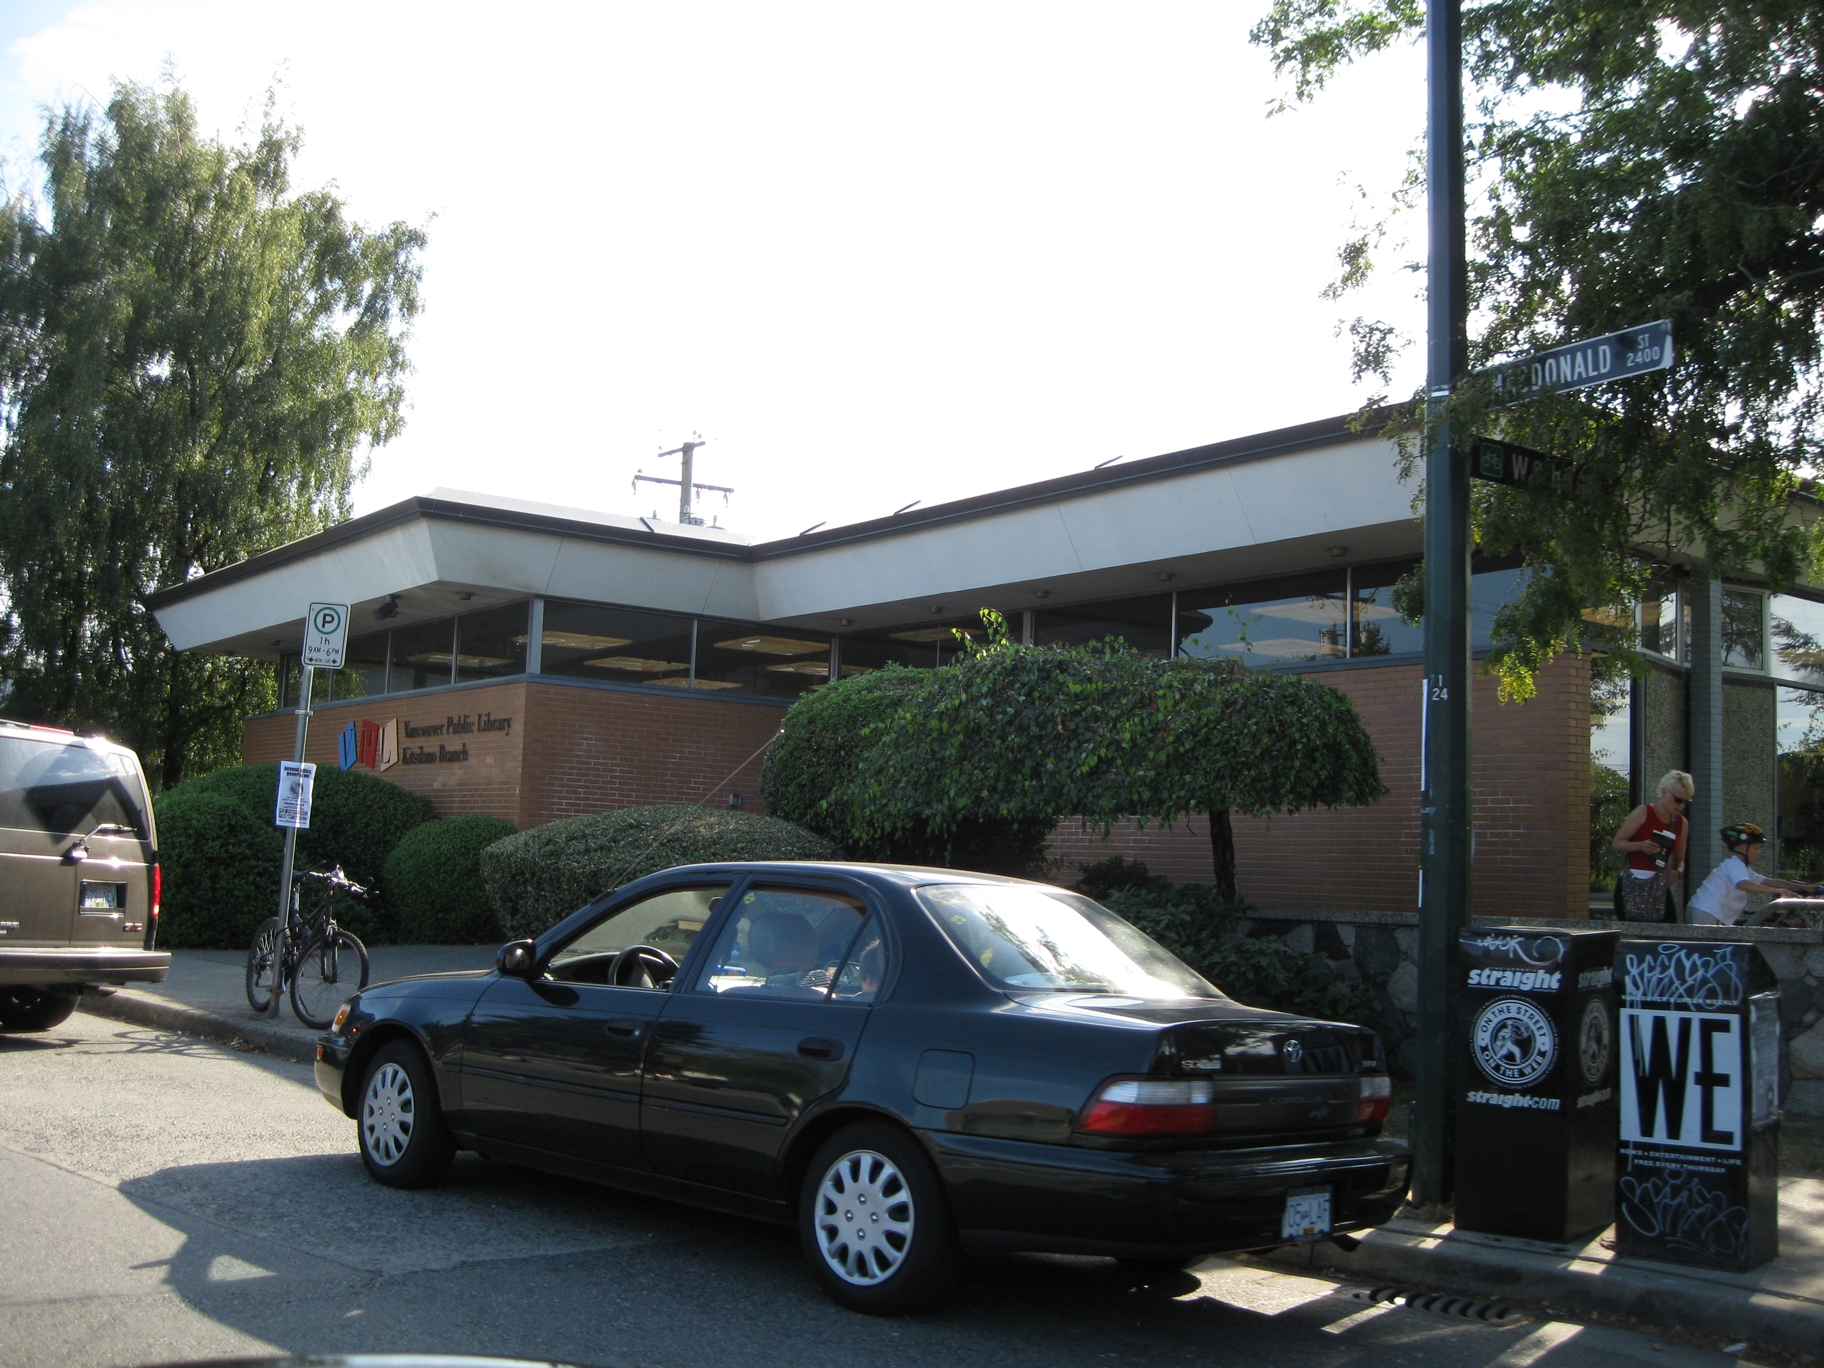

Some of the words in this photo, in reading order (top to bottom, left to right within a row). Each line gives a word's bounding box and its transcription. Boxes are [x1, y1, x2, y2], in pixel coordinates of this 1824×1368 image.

[1638, 334, 1649, 349] ST
[1627, 346, 1660, 367] 2400
[1511, 454, 1529, 481] W
[321, 613, 335, 629] P
[1432, 688, 1449, 701] 24
[404, 720, 445, 738] Vancouver
[446, 715, 475, 735] Public
[477, 712, 512, 736] Library
[439, 742, 469, 762] Branch
[1467, 967, 1562, 991] straight
[1481, 1017, 1493, 1033] ON
[1491, 1005, 1512, 1018] THE
[1516, 1006, 1547, 1037] STREET
[1483, 1051, 1497, 1068] ON
[1499, 1067, 1520, 1078] THE
[1522, 1055, 1544, 1075] WEB
[1628, 1014, 1734, 1145] WE
[1649, 1151, 1716, 1162] ENTERTAINMENT
[1655, 1161, 1681, 1169] EVERY
[1682, 1163, 1726, 1173] THURSDAY
